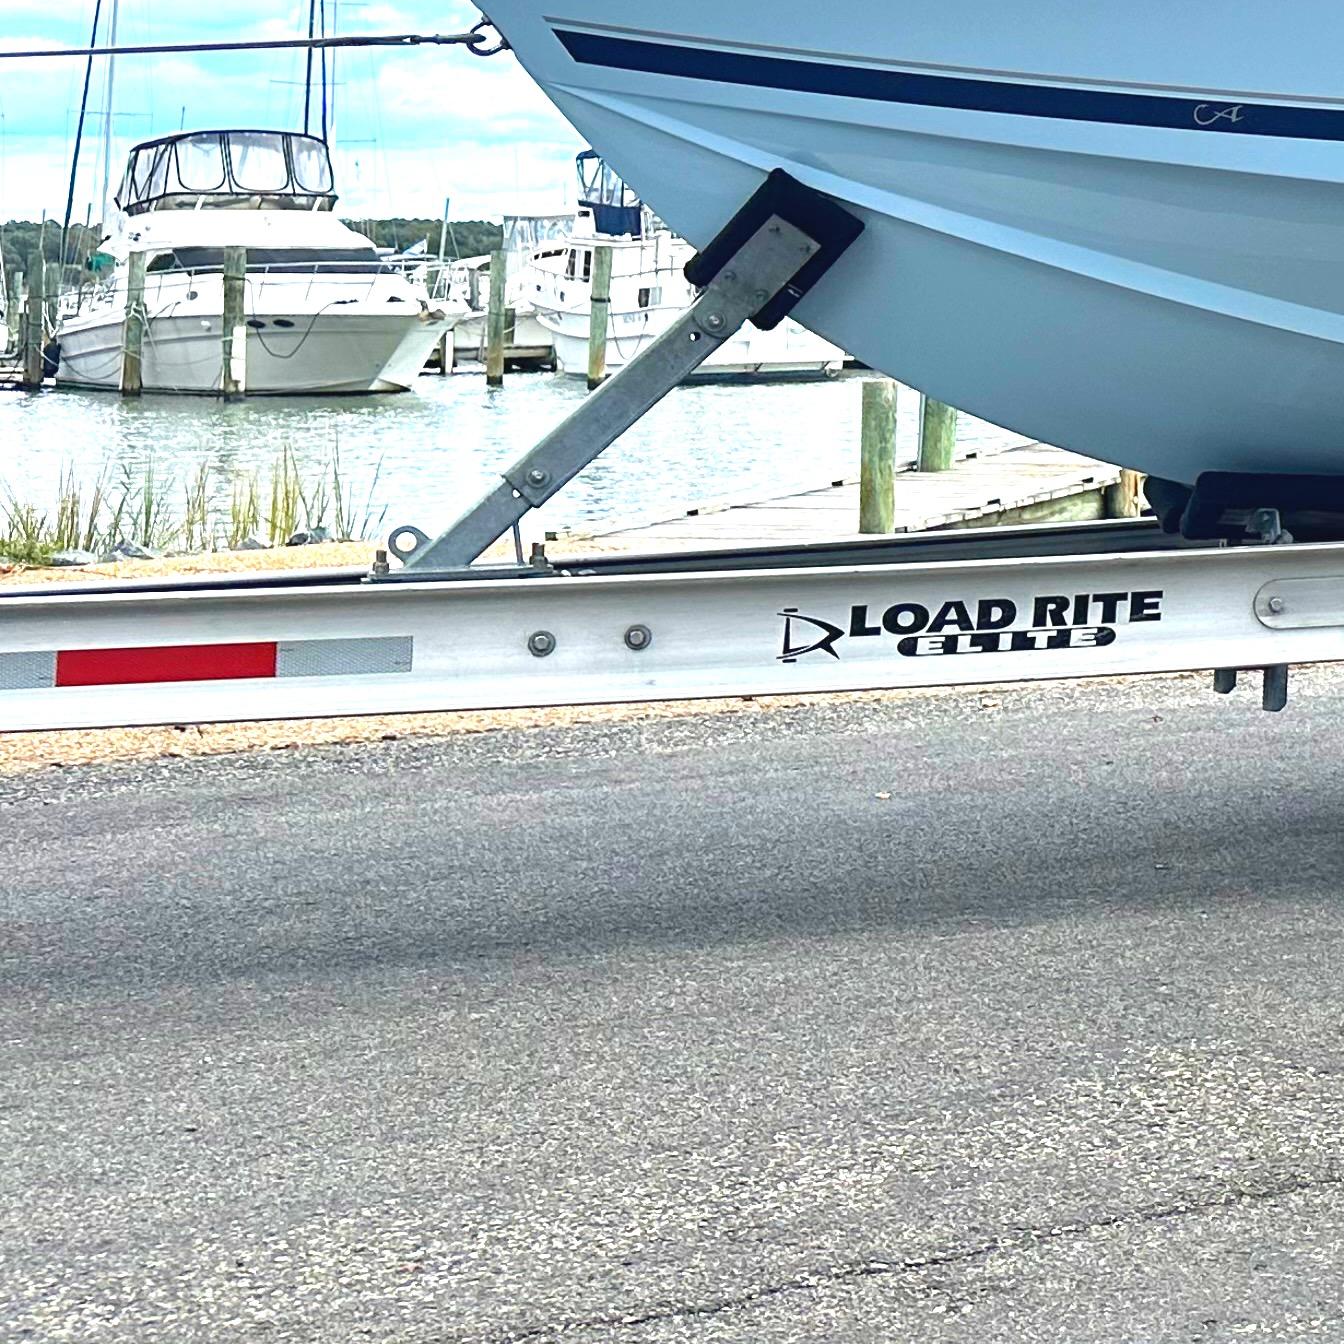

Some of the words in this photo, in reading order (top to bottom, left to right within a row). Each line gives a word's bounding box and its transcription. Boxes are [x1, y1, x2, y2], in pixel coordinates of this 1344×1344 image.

[848, 597, 1018, 637] LOAD
[1031, 589, 1164, 629] RITE
[914, 627, 1100, 655] ELITE
